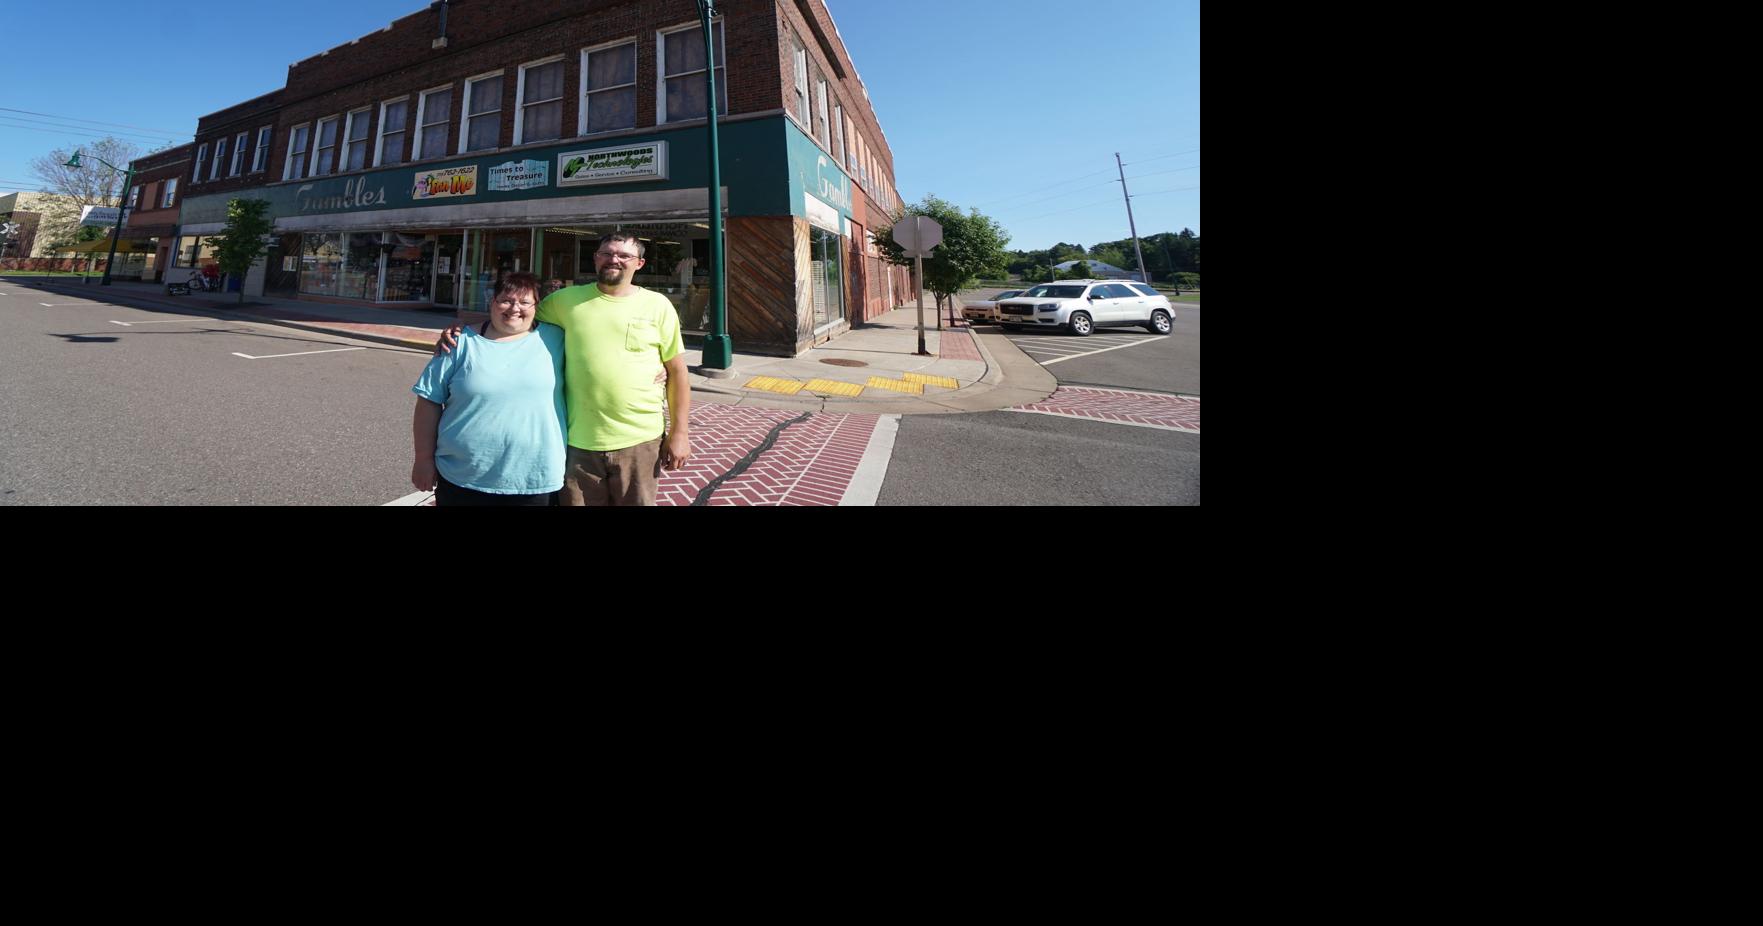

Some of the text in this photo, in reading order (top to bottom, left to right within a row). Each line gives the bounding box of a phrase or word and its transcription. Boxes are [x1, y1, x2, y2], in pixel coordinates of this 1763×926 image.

[588, 147, 653, 161] NORTHWOODS
[586, 155, 653, 170] Technologies
[506, 172, 543, 181] Treasure
